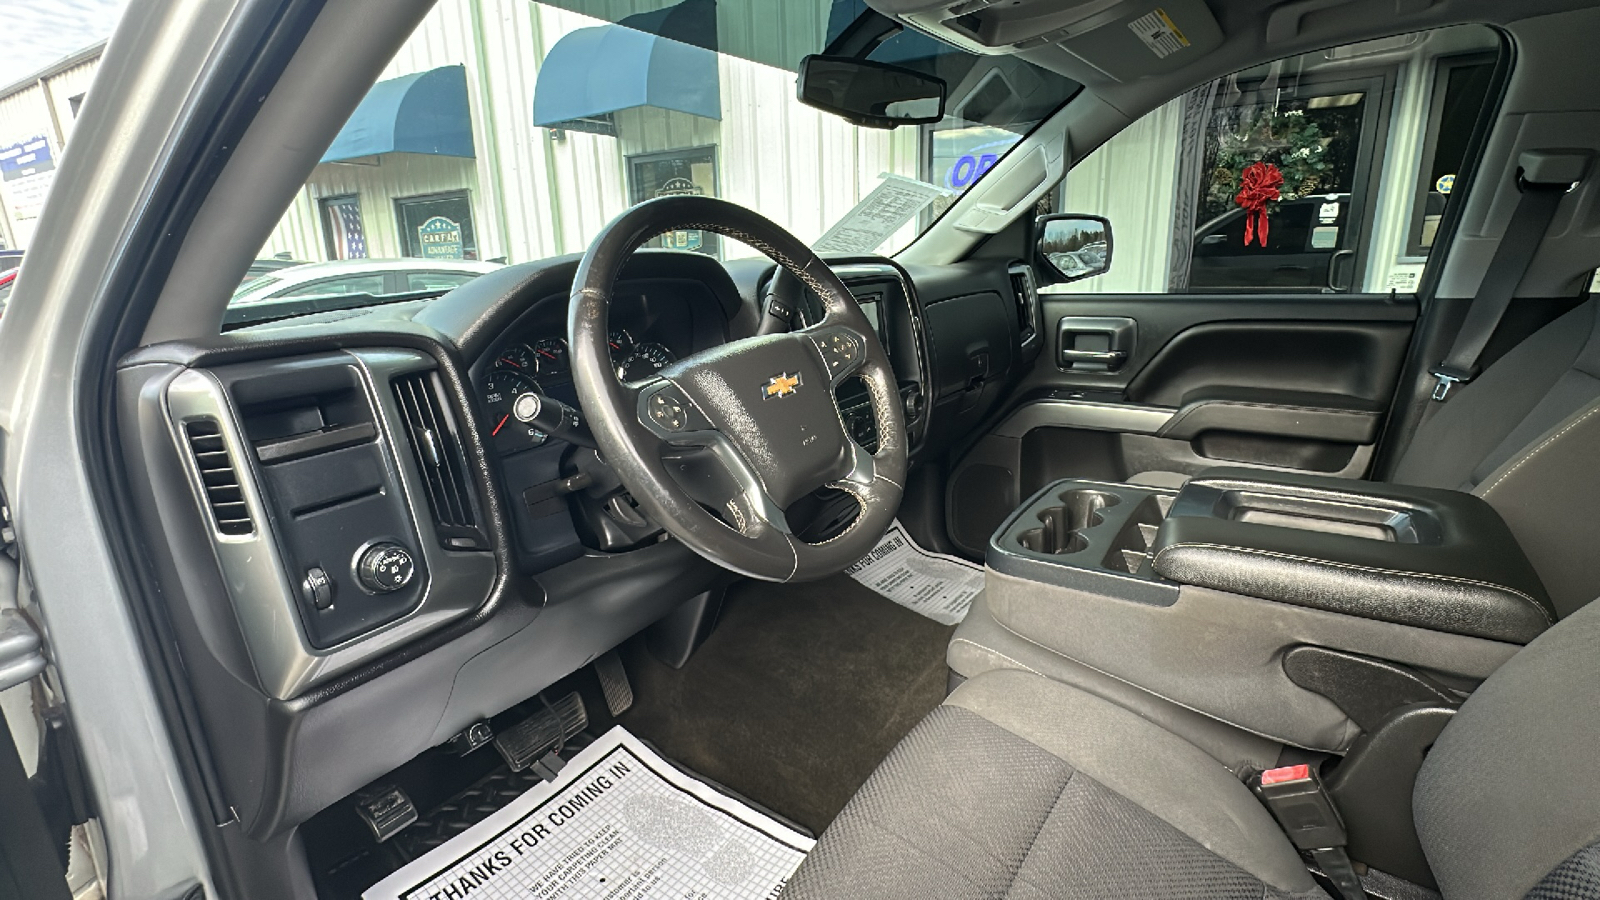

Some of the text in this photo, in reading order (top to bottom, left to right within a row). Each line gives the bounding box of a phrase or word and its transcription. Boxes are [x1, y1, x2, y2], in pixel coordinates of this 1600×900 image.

[510, 823, 551, 856] FOR
[548, 776, 613, 827] COMING
[610, 761, 631, 780] IN
[530, 824, 611, 893] WE HAVE TRIED TO KEEP
[536, 829, 620, 899] YOUR CARPETING CLEAN
[568, 868, 586, 885] THIS
[585, 850, 609, 869] PAPER
[607, 837, 623, 850] MAT
[603, 877, 633, 900] ustomer
